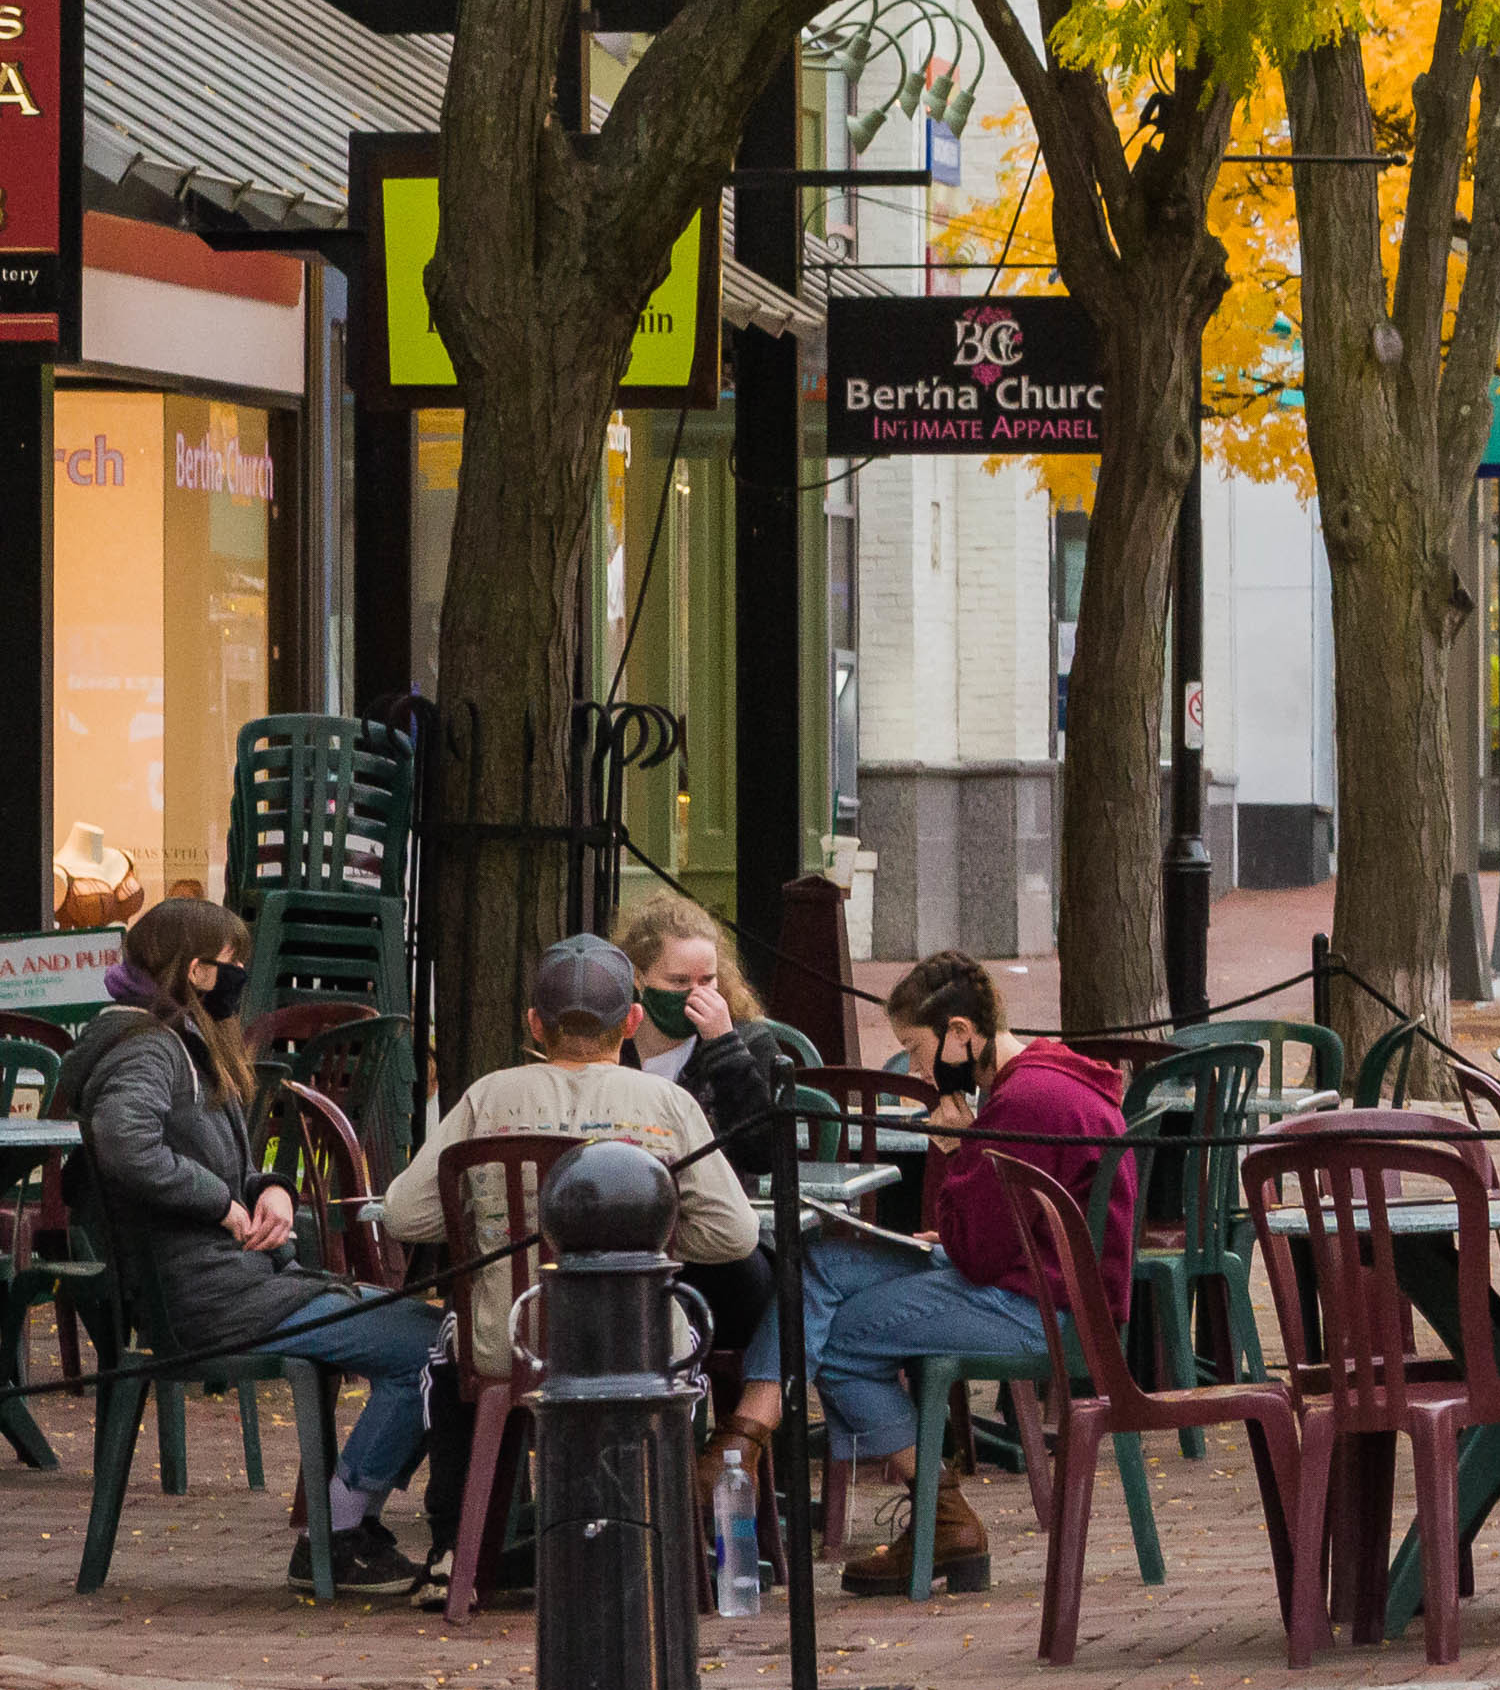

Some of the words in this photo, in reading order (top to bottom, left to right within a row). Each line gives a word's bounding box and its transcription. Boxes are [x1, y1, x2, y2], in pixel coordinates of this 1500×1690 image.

[0, 265, 39, 284] tery
[846, 376, 979, 410] Bertha
[995, 377, 1105, 410] Churc
[991, 415, 1099, 440] APPAREL
[176, 430, 223, 493] Bertha
[226, 436, 274, 501] Church
